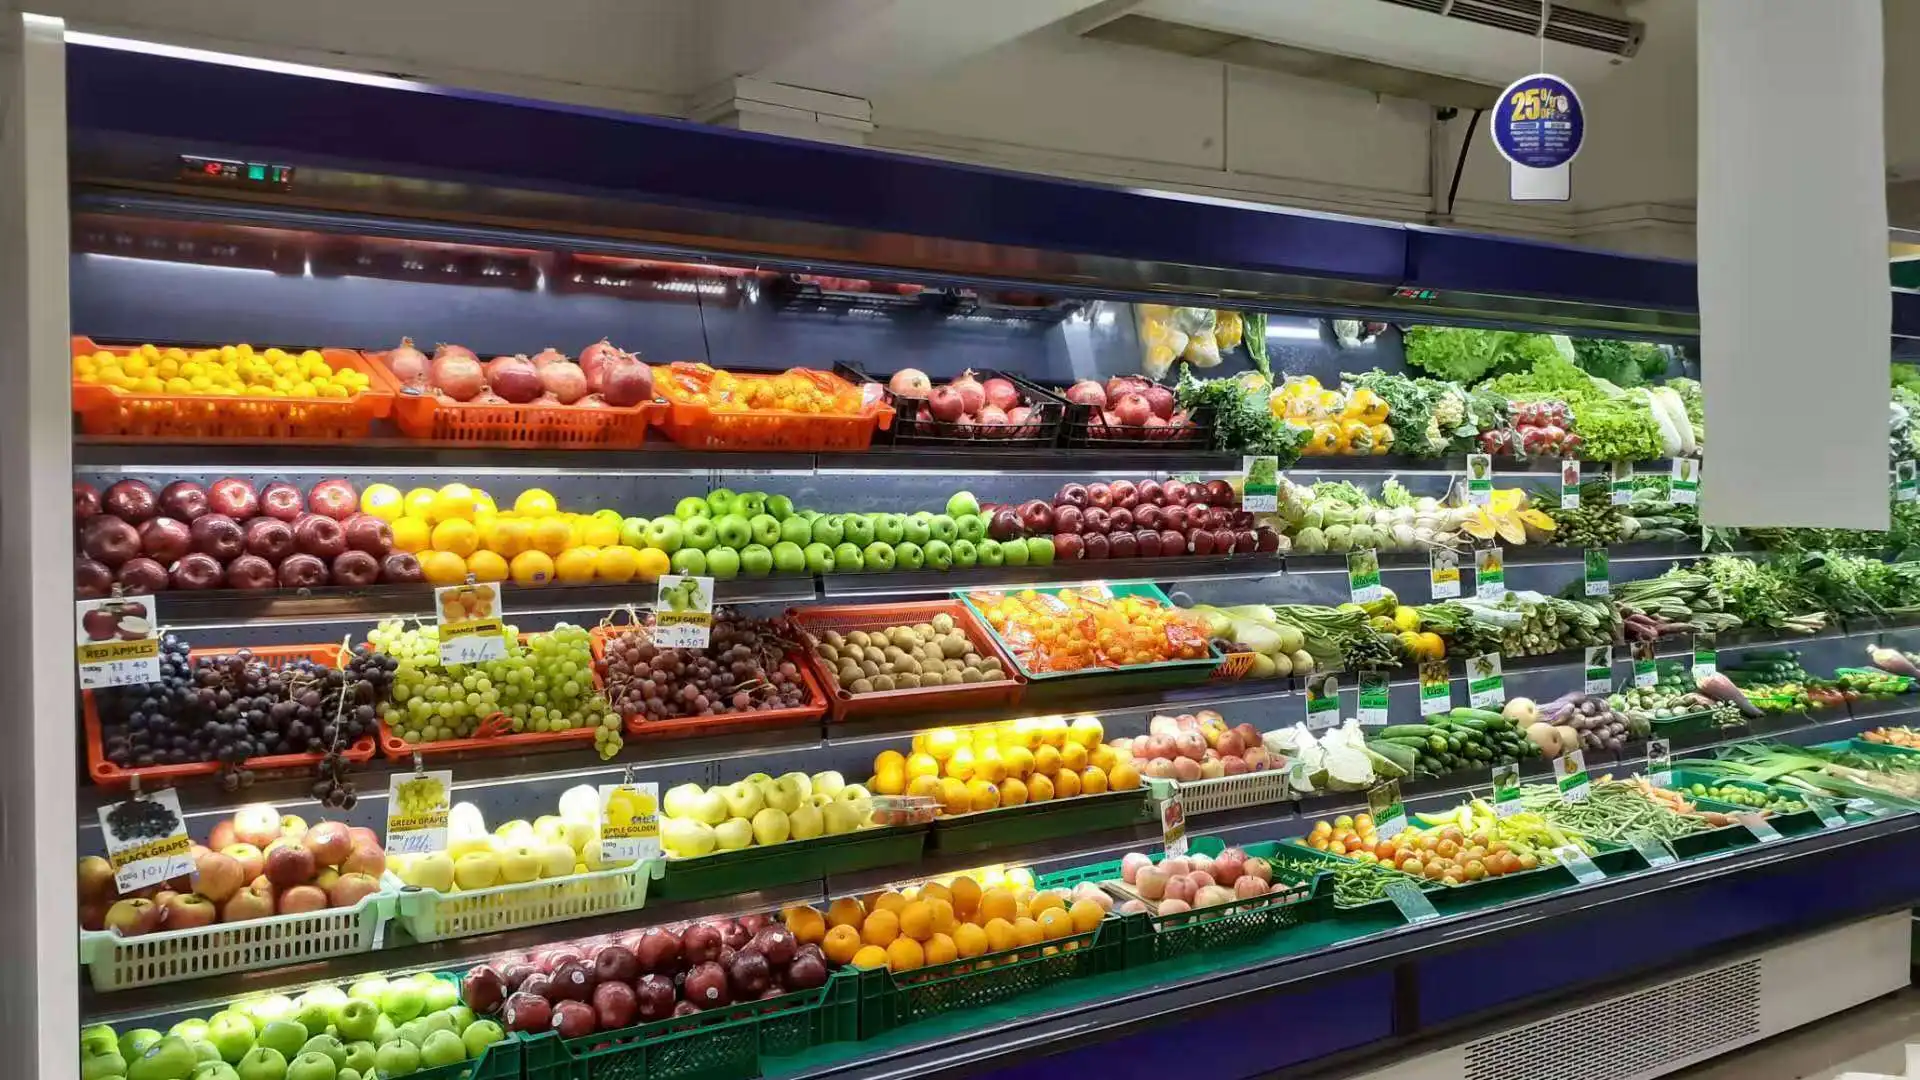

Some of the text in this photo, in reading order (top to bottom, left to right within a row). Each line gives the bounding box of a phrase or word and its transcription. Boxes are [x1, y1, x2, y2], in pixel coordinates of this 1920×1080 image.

[661, 615, 706, 624] APPLE GREEN
[86, 644, 153, 659] RED APPLES
[390, 815, 449, 828] GREEN GRAPES
[603, 824, 656, 835] APPLE GOLDEN
[116, 852, 150, 867] BLACK
[151, 838, 190, 857] GRAPES
